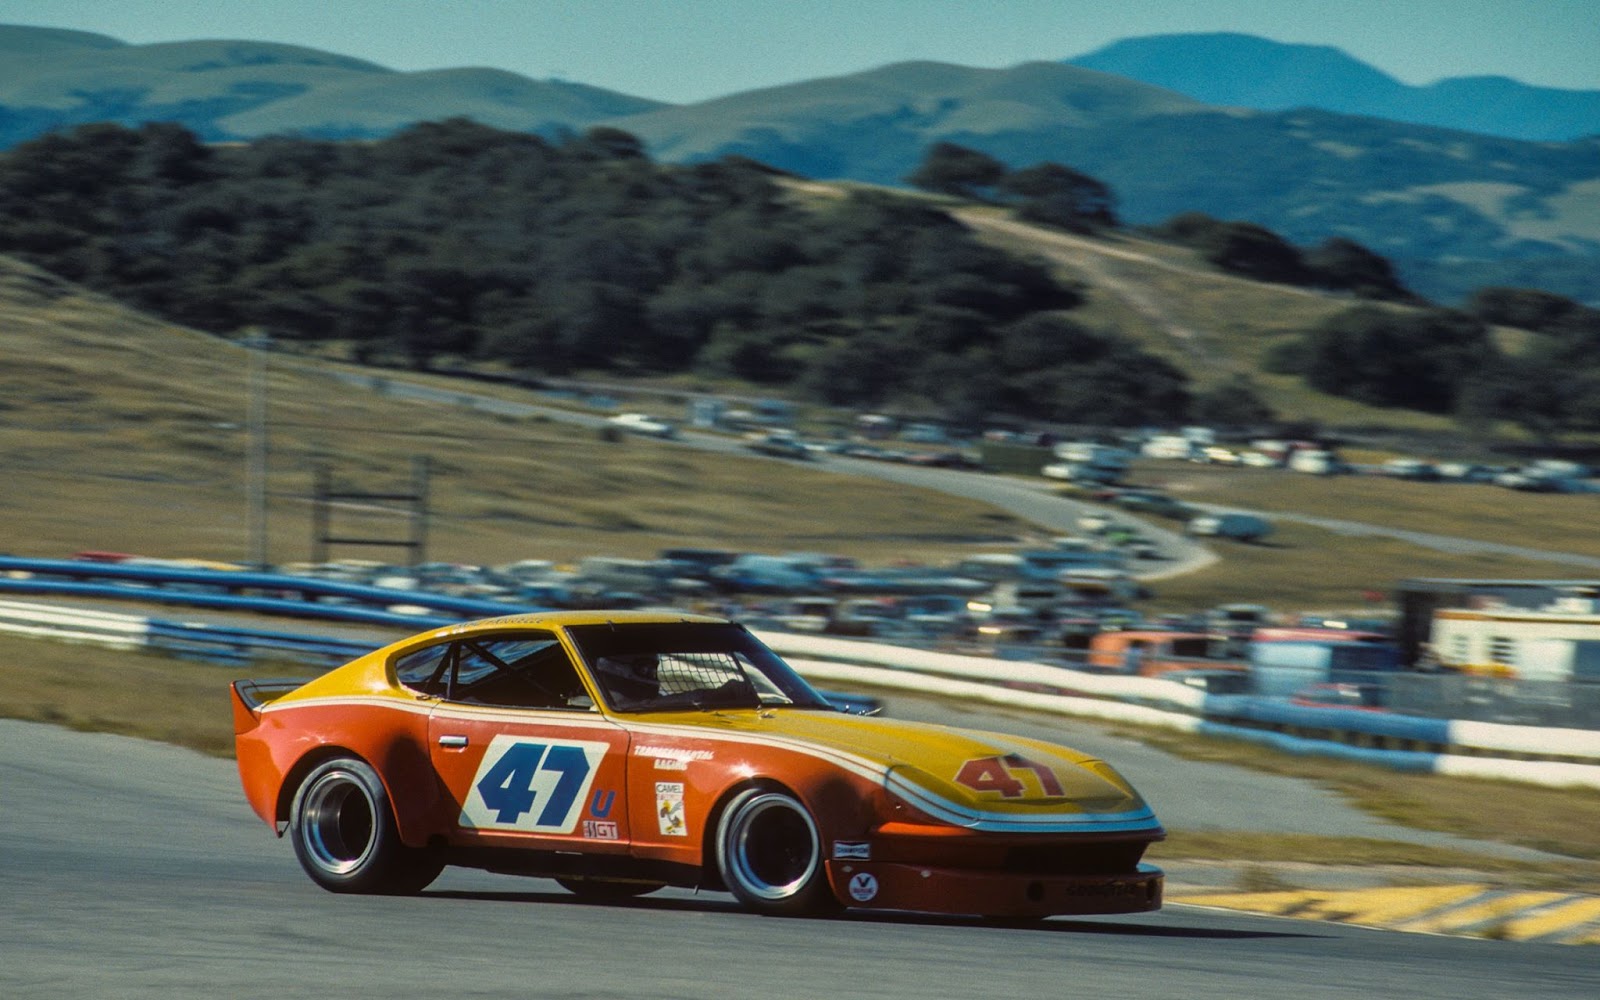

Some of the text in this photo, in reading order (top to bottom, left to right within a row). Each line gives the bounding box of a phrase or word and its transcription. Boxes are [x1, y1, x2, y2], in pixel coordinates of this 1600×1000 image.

[477, 743, 590, 827] 47
[656, 784, 684, 794] CAMEL
[953, 754, 1066, 799] 47
[591, 789, 616, 818] U
[597, 823, 616, 837] GT
